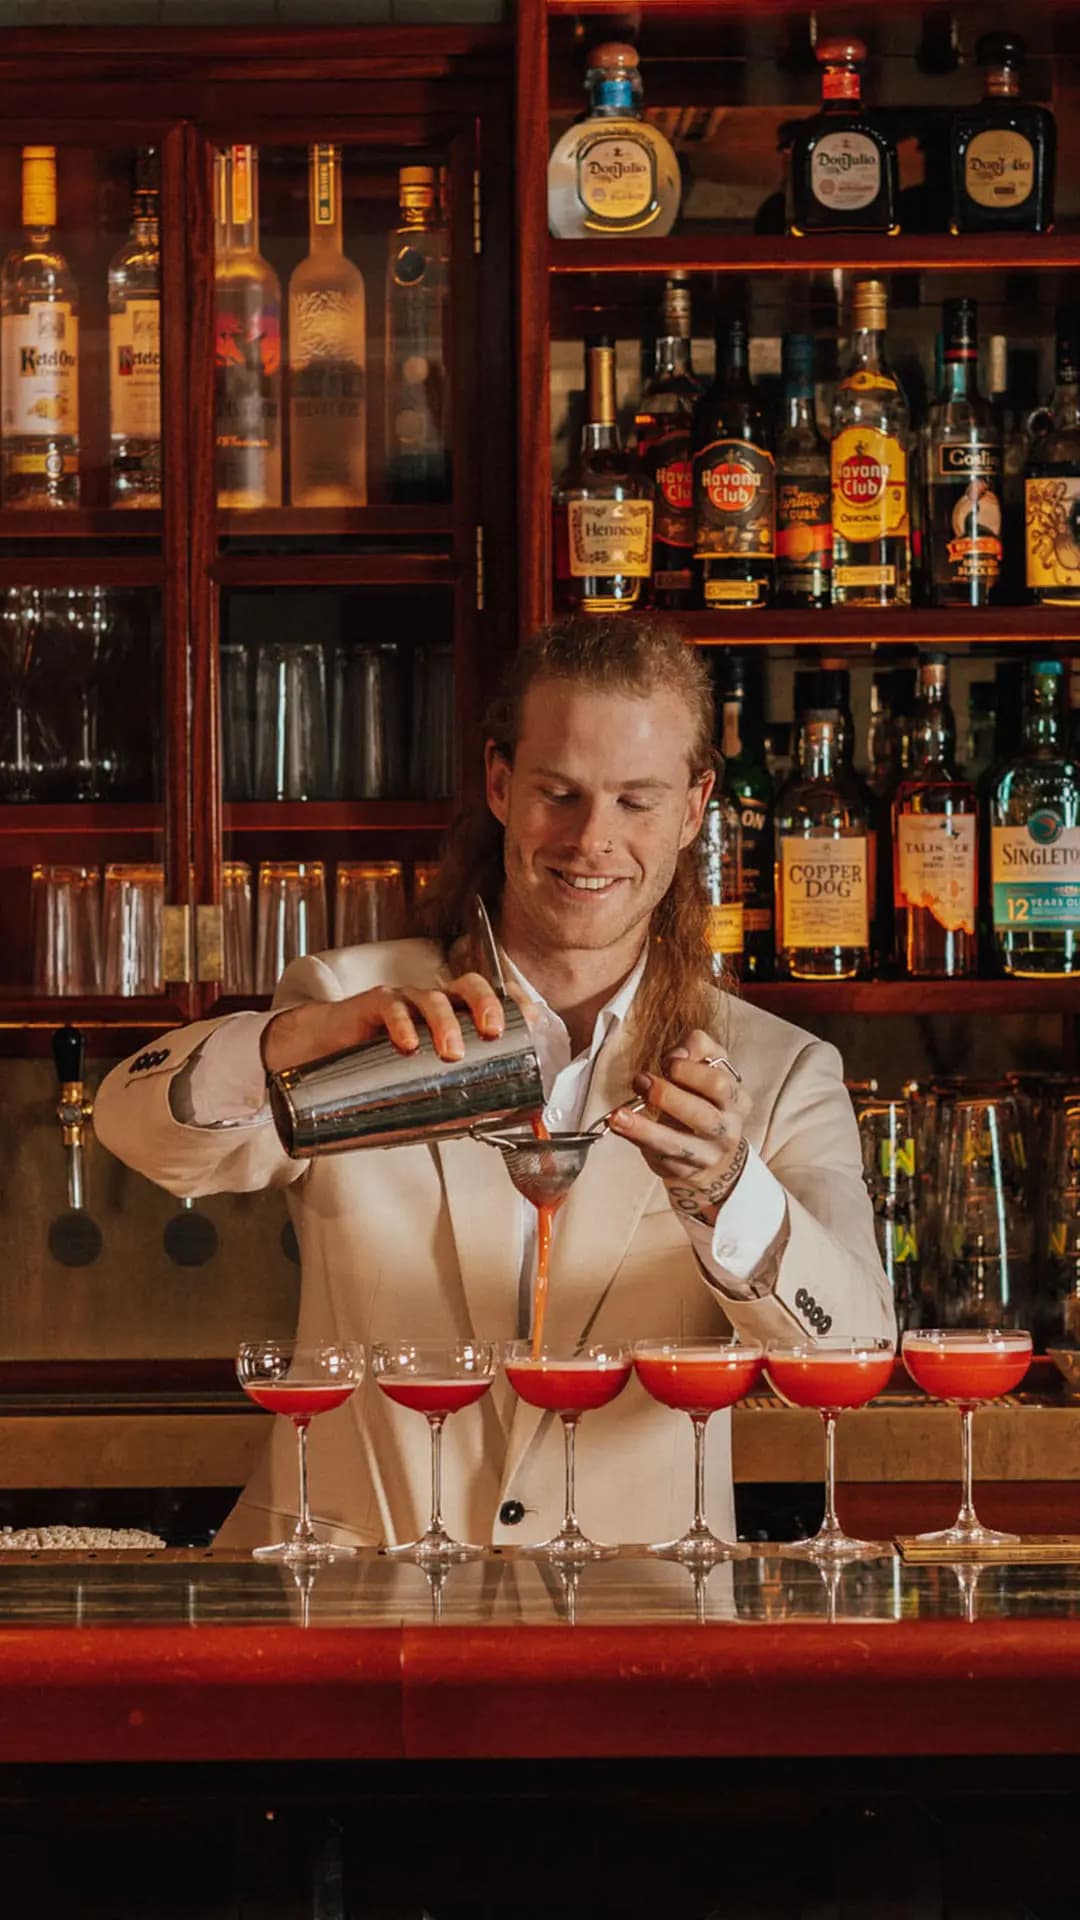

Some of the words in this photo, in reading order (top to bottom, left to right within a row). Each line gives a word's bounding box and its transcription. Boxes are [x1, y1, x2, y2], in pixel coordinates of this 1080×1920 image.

[656, 467, 692, 484] Hava
[702, 469, 762, 487] Havana
[667, 484, 692, 500] Clu
[713, 486, 749, 503] Club
[843, 479, 878, 496] Club
[905, 842, 969, 853] TALISER
[1002, 844, 1080, 865] SINGLETO
[789, 864, 863, 885] COPPER
[805, 880, 851, 898] DOG
[1006, 898, 1029, 921] 12
[1066, 898, 1080, 907] OL
